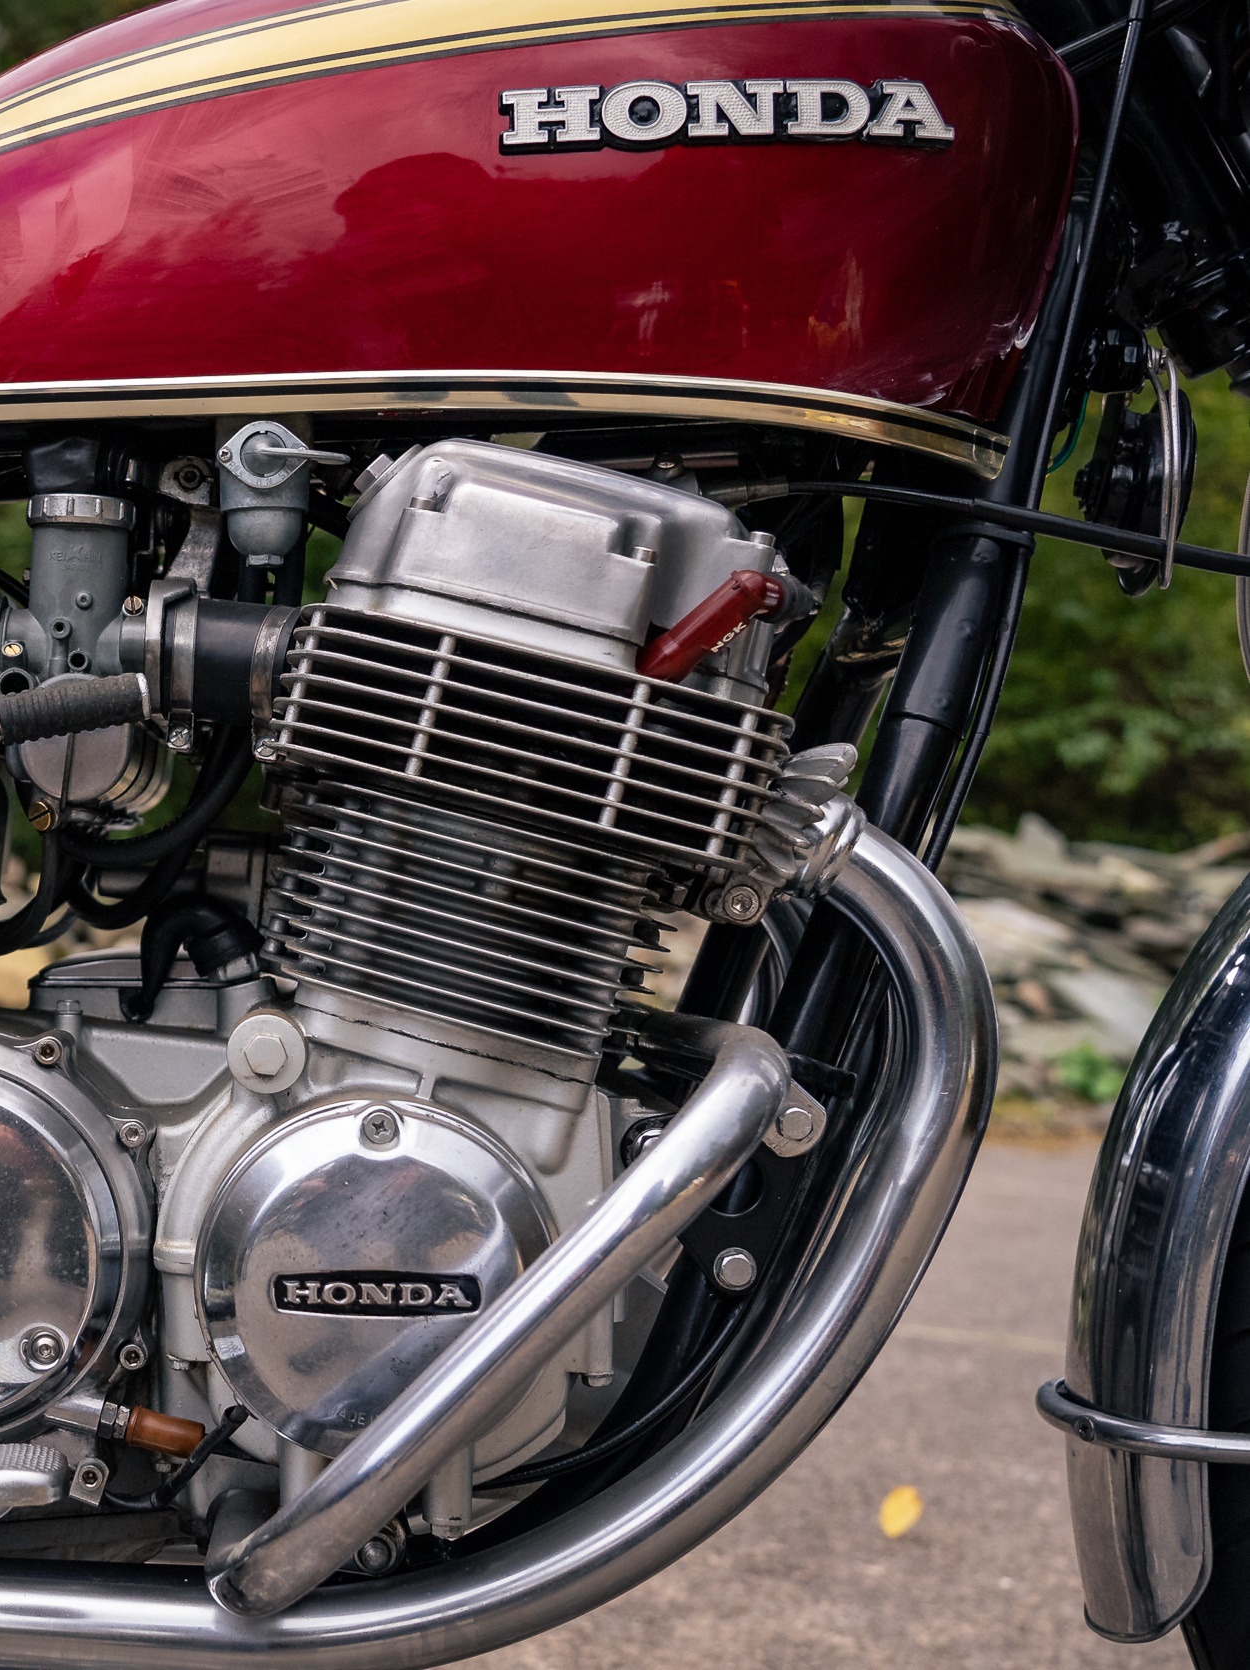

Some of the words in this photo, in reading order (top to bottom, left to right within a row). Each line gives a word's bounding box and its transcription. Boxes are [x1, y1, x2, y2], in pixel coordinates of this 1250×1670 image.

[501, 79, 956, 149] HONDA
[711, 621, 748, 653] NGK
[283, 1280, 473, 1307] HONDA
